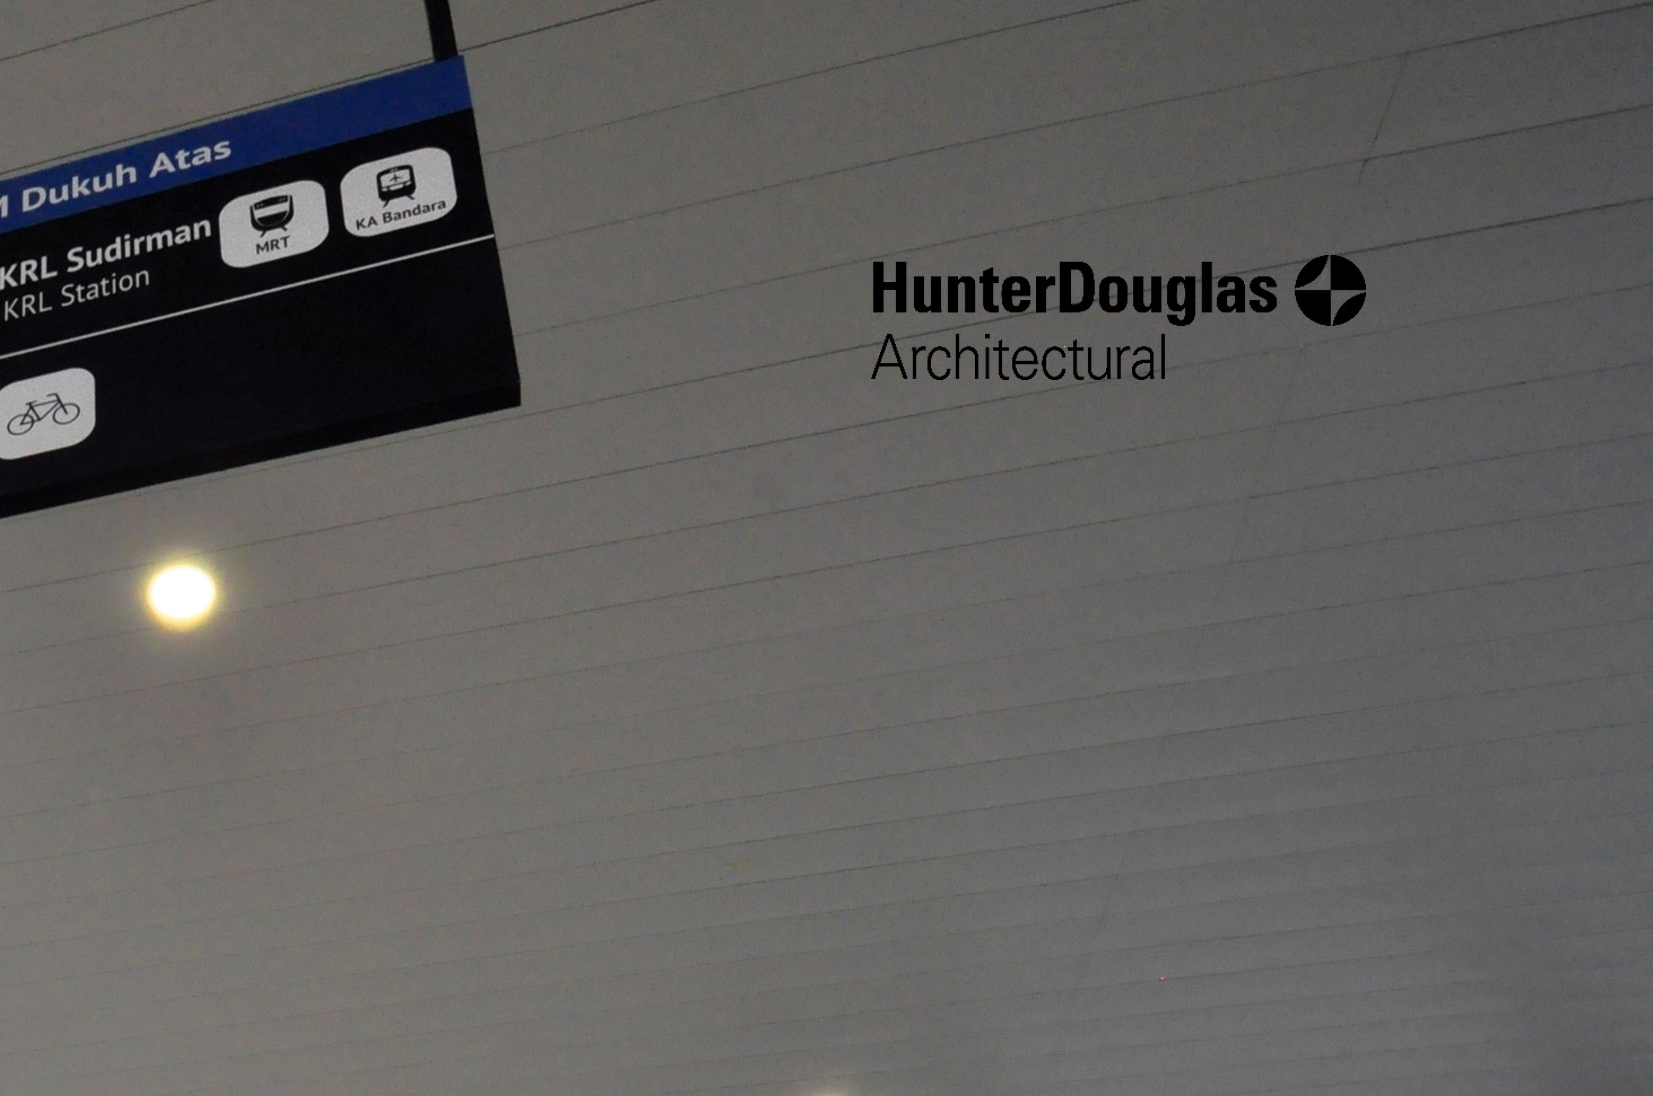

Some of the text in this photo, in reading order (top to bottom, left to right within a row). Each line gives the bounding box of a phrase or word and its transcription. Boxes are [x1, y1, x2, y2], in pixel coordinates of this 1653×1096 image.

[22, 163, 137, 212] Dukuh
[149, 140, 232, 178] Atas
[355, 200, 446, 230] KA Bandara
[67, 219, 212, 272] Sudirman
[255, 235, 290, 254] MRT
[4, 292, 52, 321] KRL
[61, 270, 150, 307] Station
